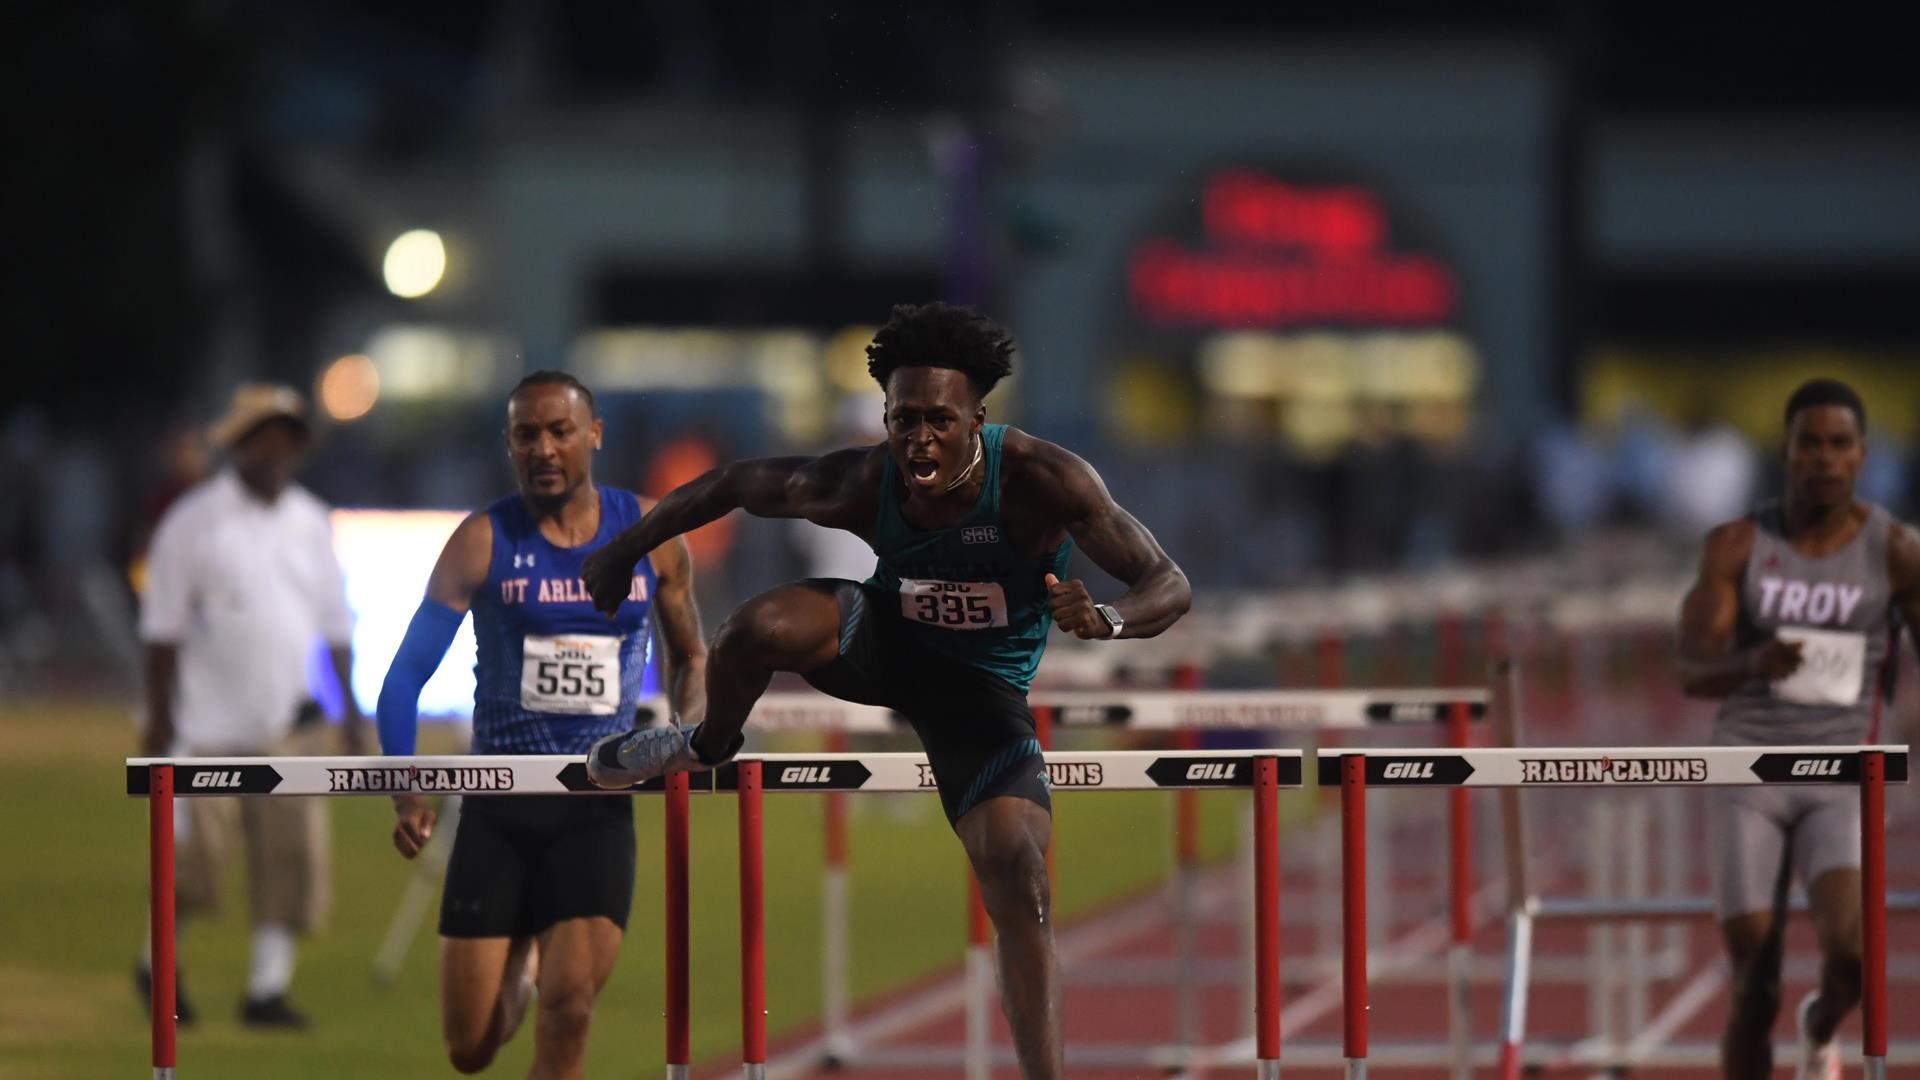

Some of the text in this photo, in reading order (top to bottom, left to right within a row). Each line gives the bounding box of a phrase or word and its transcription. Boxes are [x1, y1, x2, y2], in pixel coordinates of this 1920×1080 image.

[961, 526, 999, 544] SBC
[501, 575, 649, 605] UT ARLIN
[915, 594, 992, 625] 335
[1758, 576, 1863, 626] TROY
[536, 661, 605, 697] 555
[780, 766, 831, 784] GILL
[1185, 763, 1237, 780] GILL
[1383, 762, 1434, 779] GILL
[1790, 759, 1842, 776] GILL
[192, 771, 242, 788] GILL
